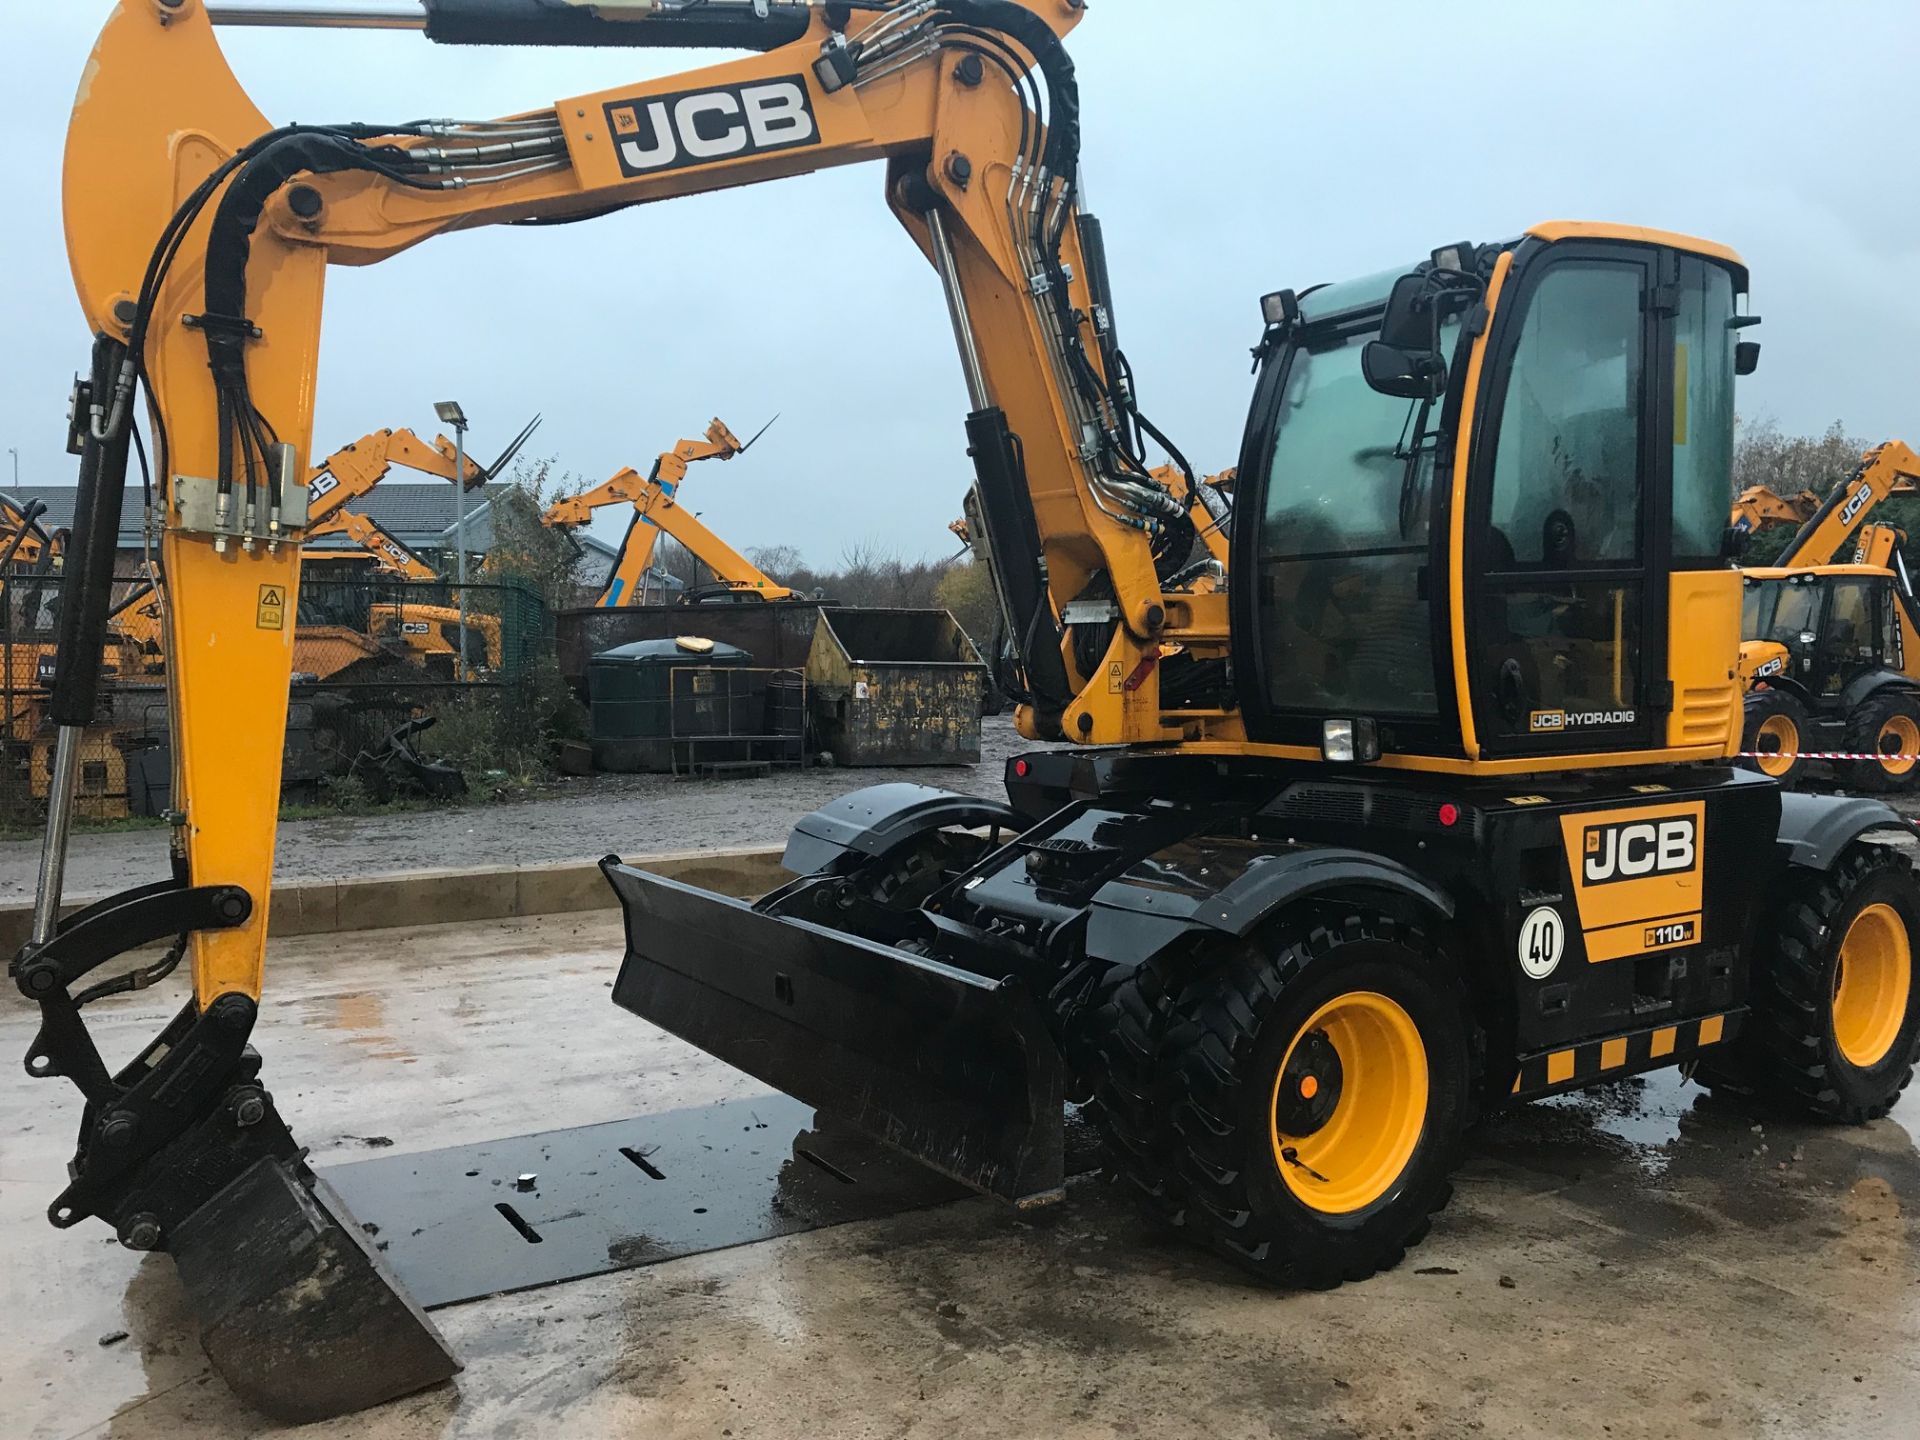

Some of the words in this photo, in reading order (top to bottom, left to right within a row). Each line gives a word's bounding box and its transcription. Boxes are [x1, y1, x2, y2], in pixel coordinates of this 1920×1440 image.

[620, 82, 813, 169] JCB
[1841, 483, 1872, 525] JCB
[383, 544, 410, 565] JCB
[1533, 714, 1562, 727] JCB
[1564, 710, 1635, 726] HYDRADIG
[1585, 820, 1694, 881] JCB
[1529, 921, 1554, 964] 40
